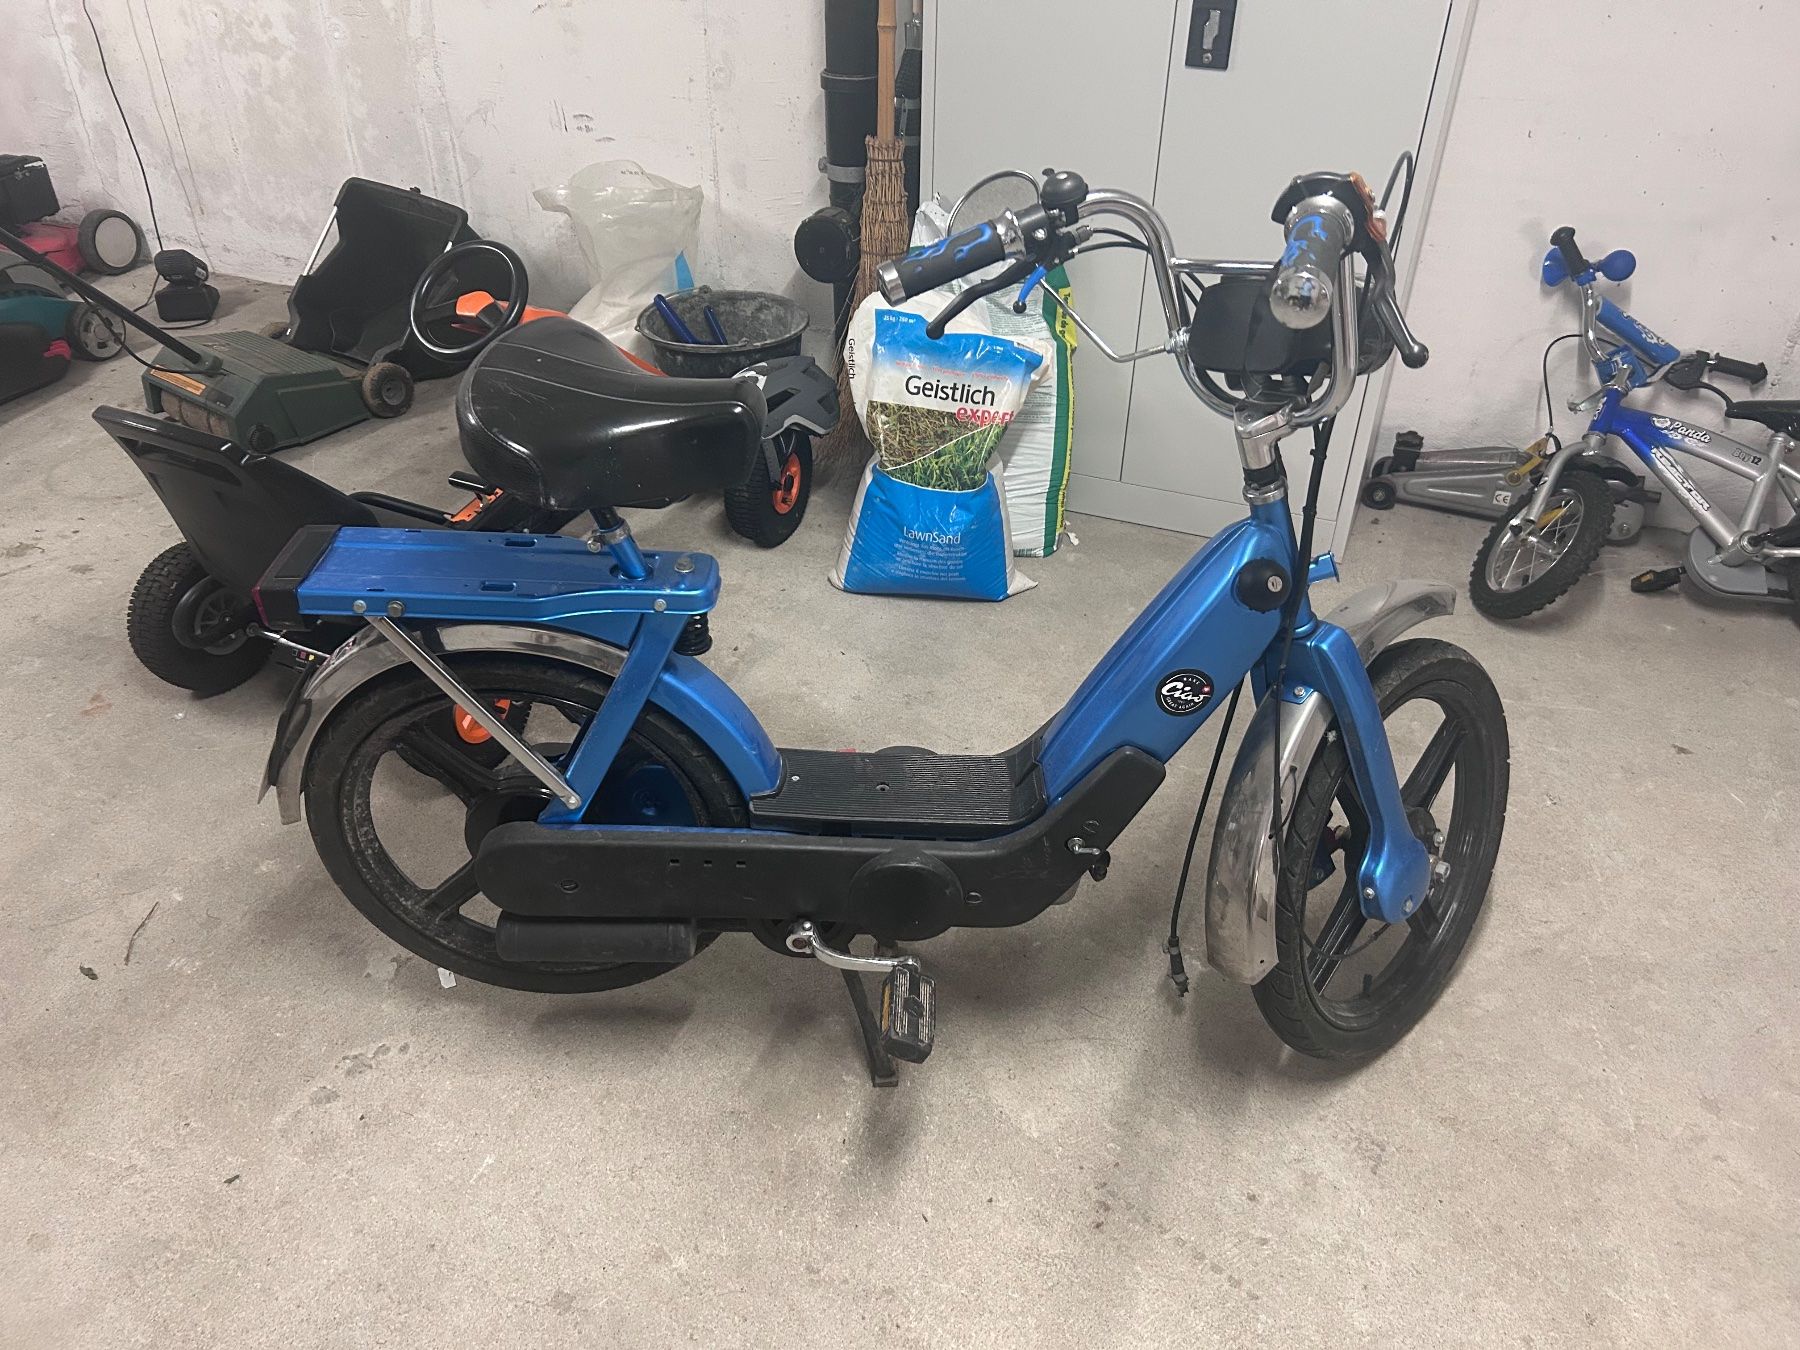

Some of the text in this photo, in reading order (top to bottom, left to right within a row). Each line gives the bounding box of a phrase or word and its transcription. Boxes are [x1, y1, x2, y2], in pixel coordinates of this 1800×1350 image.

[848, 338, 856, 379] Geistlich
[905, 375, 996, 406] Geistlich
[955, 405, 1015, 428] expert
[1669, 421, 1711, 444] Panda
[1495, 493, 1509, 505] CE
[903, 526, 961, 544] LawnSand
[1161, 681, 1211, 702] Ciao
